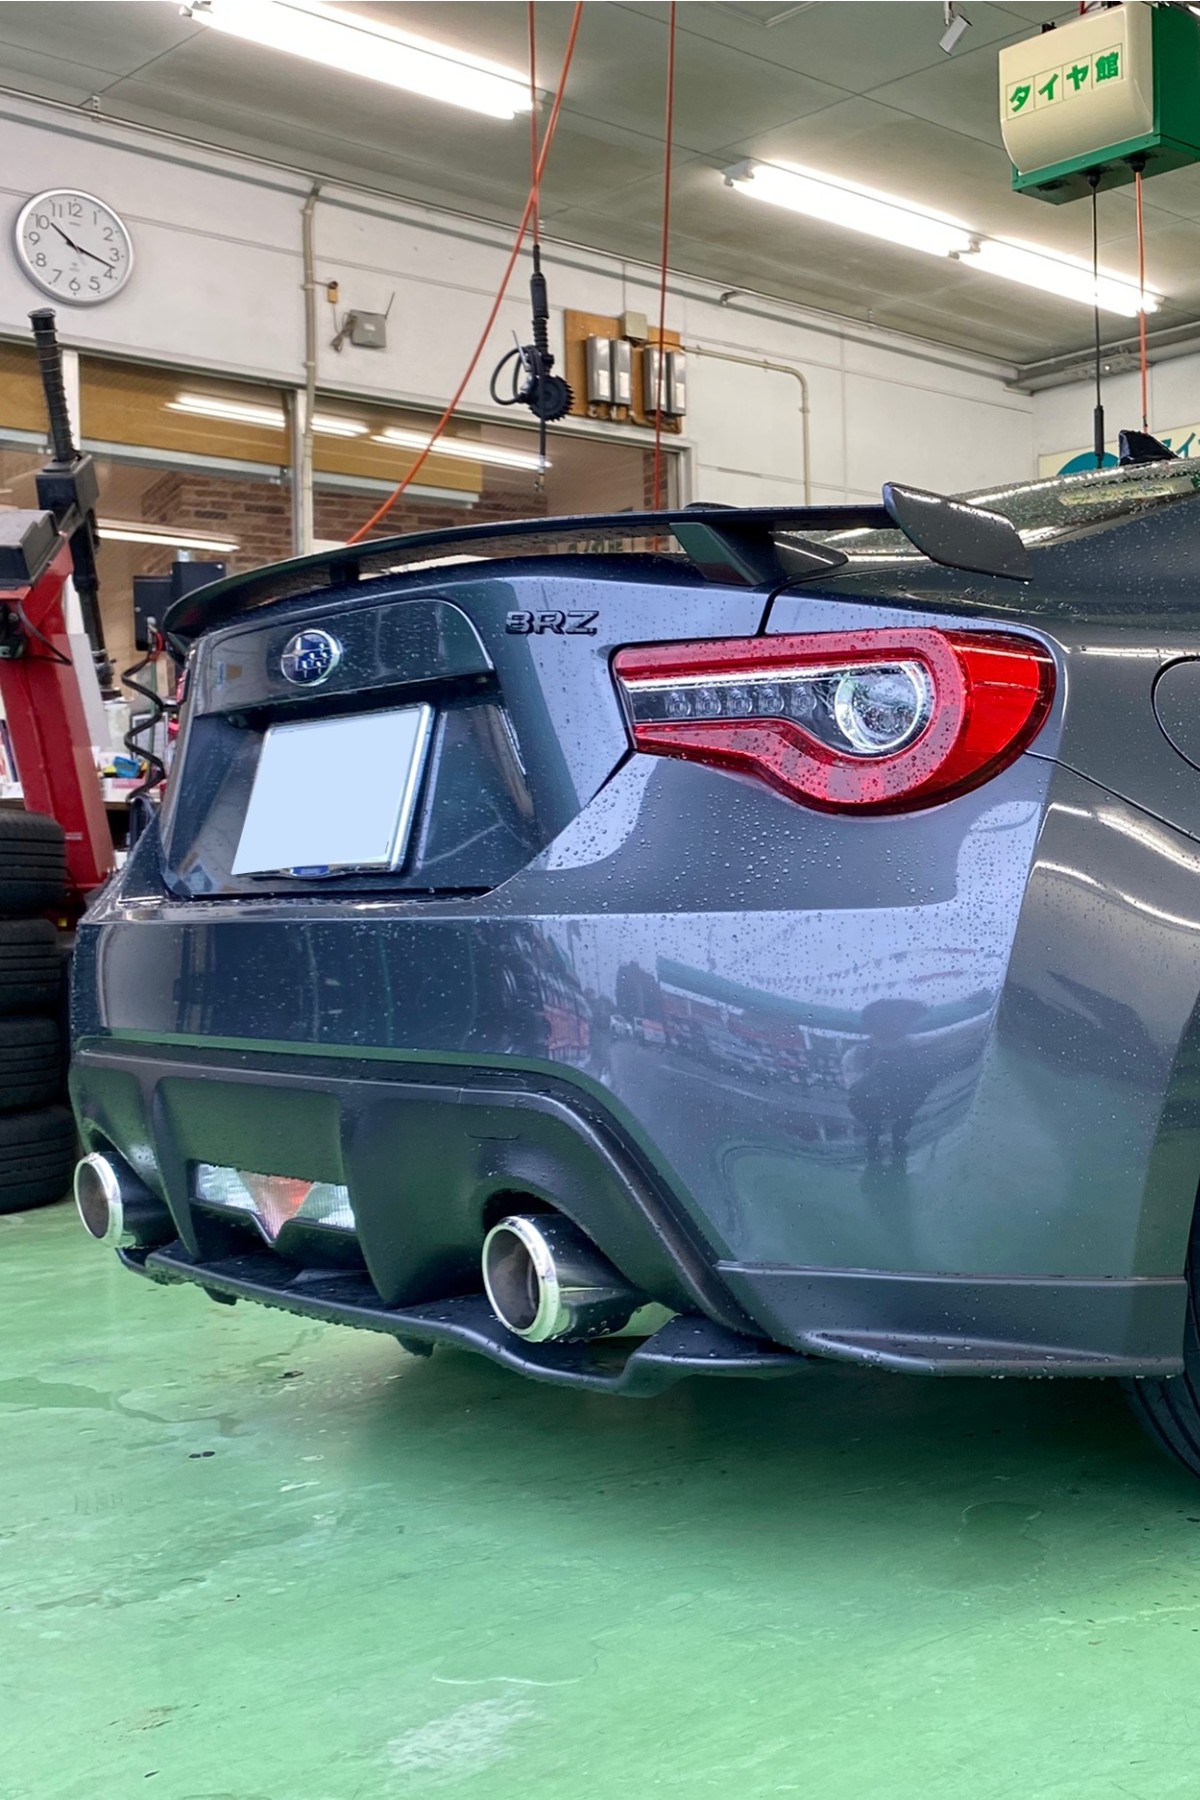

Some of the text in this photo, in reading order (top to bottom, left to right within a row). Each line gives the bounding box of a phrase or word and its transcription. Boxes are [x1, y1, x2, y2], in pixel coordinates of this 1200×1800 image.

[1010, 51, 1119, 113] タイヤ館
[68, 202, 82, 218] 12
[35, 213, 50, 230] 10
[28, 231, 40, 245] 9
[103, 226, 113, 242] 2
[35, 252, 47, 267] 8
[109, 247, 120, 262] 3
[52, 269, 62, 283] 7
[89, 276, 100, 291] 5
[69, 277, 80, 291] 6
[505, 610, 600, 635] BRZ
